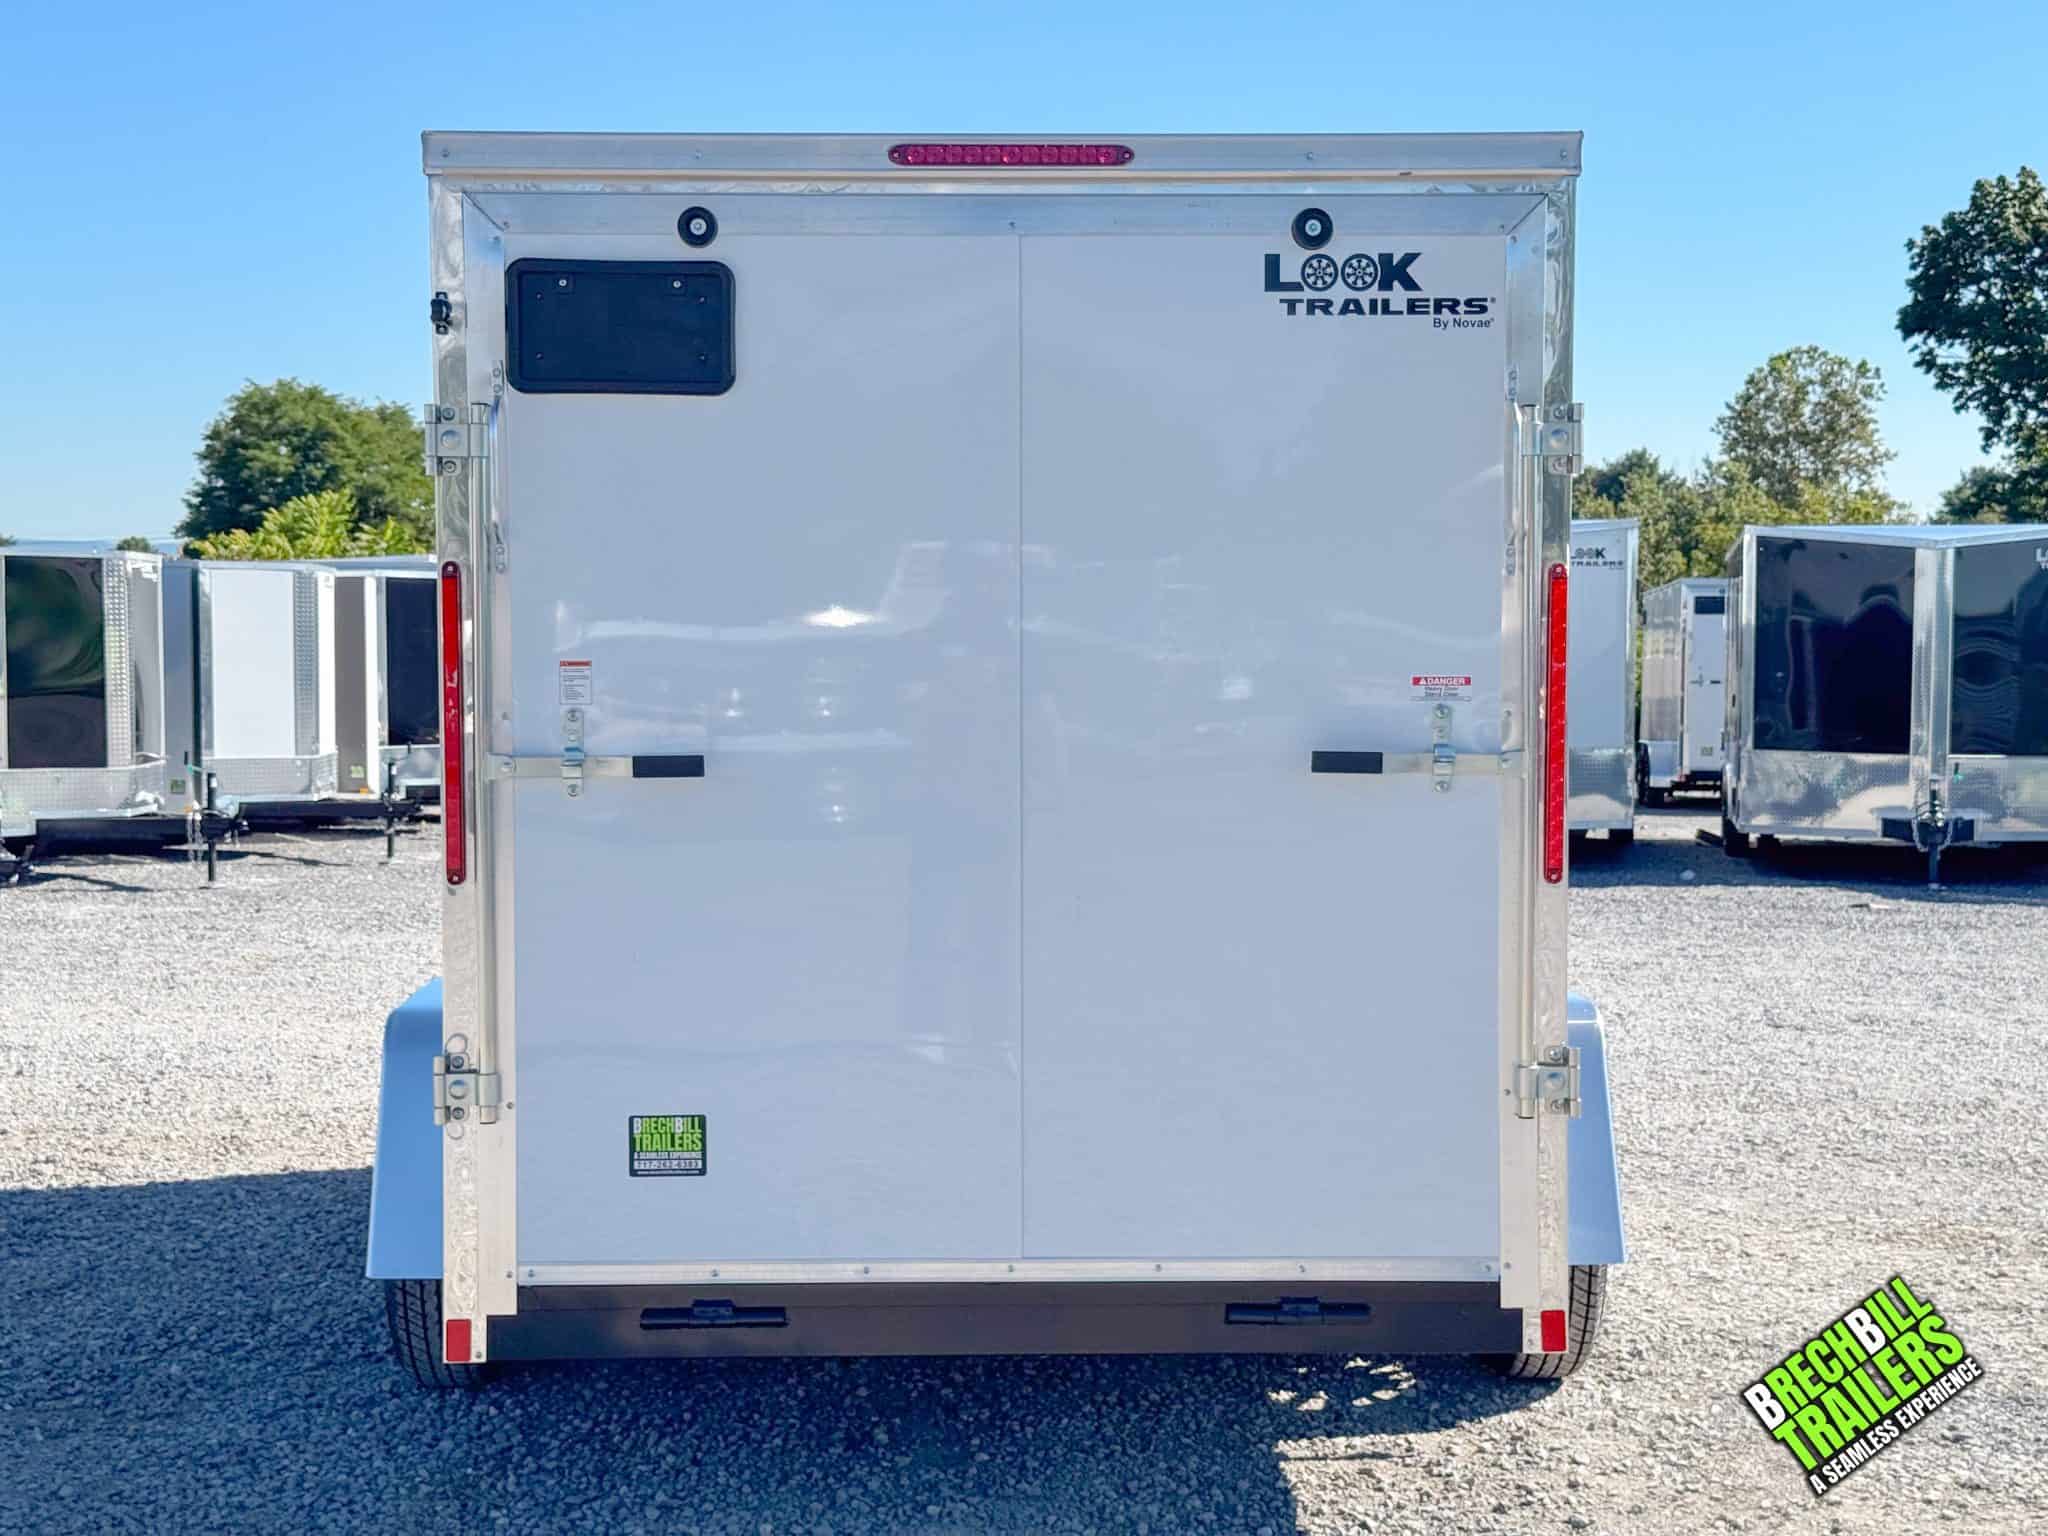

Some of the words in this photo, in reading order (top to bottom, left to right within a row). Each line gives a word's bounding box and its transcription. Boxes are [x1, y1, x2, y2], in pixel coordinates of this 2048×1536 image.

[1264, 252, 1423, 292] LOOK
[1280, 298, 1490, 316] TRAILERS
[1433, 317, 1449, 330] By
[1453, 317, 1491, 328] Novae
[1427, 677, 1465, 686] DANGER
[633, 1116, 702, 1134] BRECHBILL
[633, 1133, 703, 1152] TRAILERS
